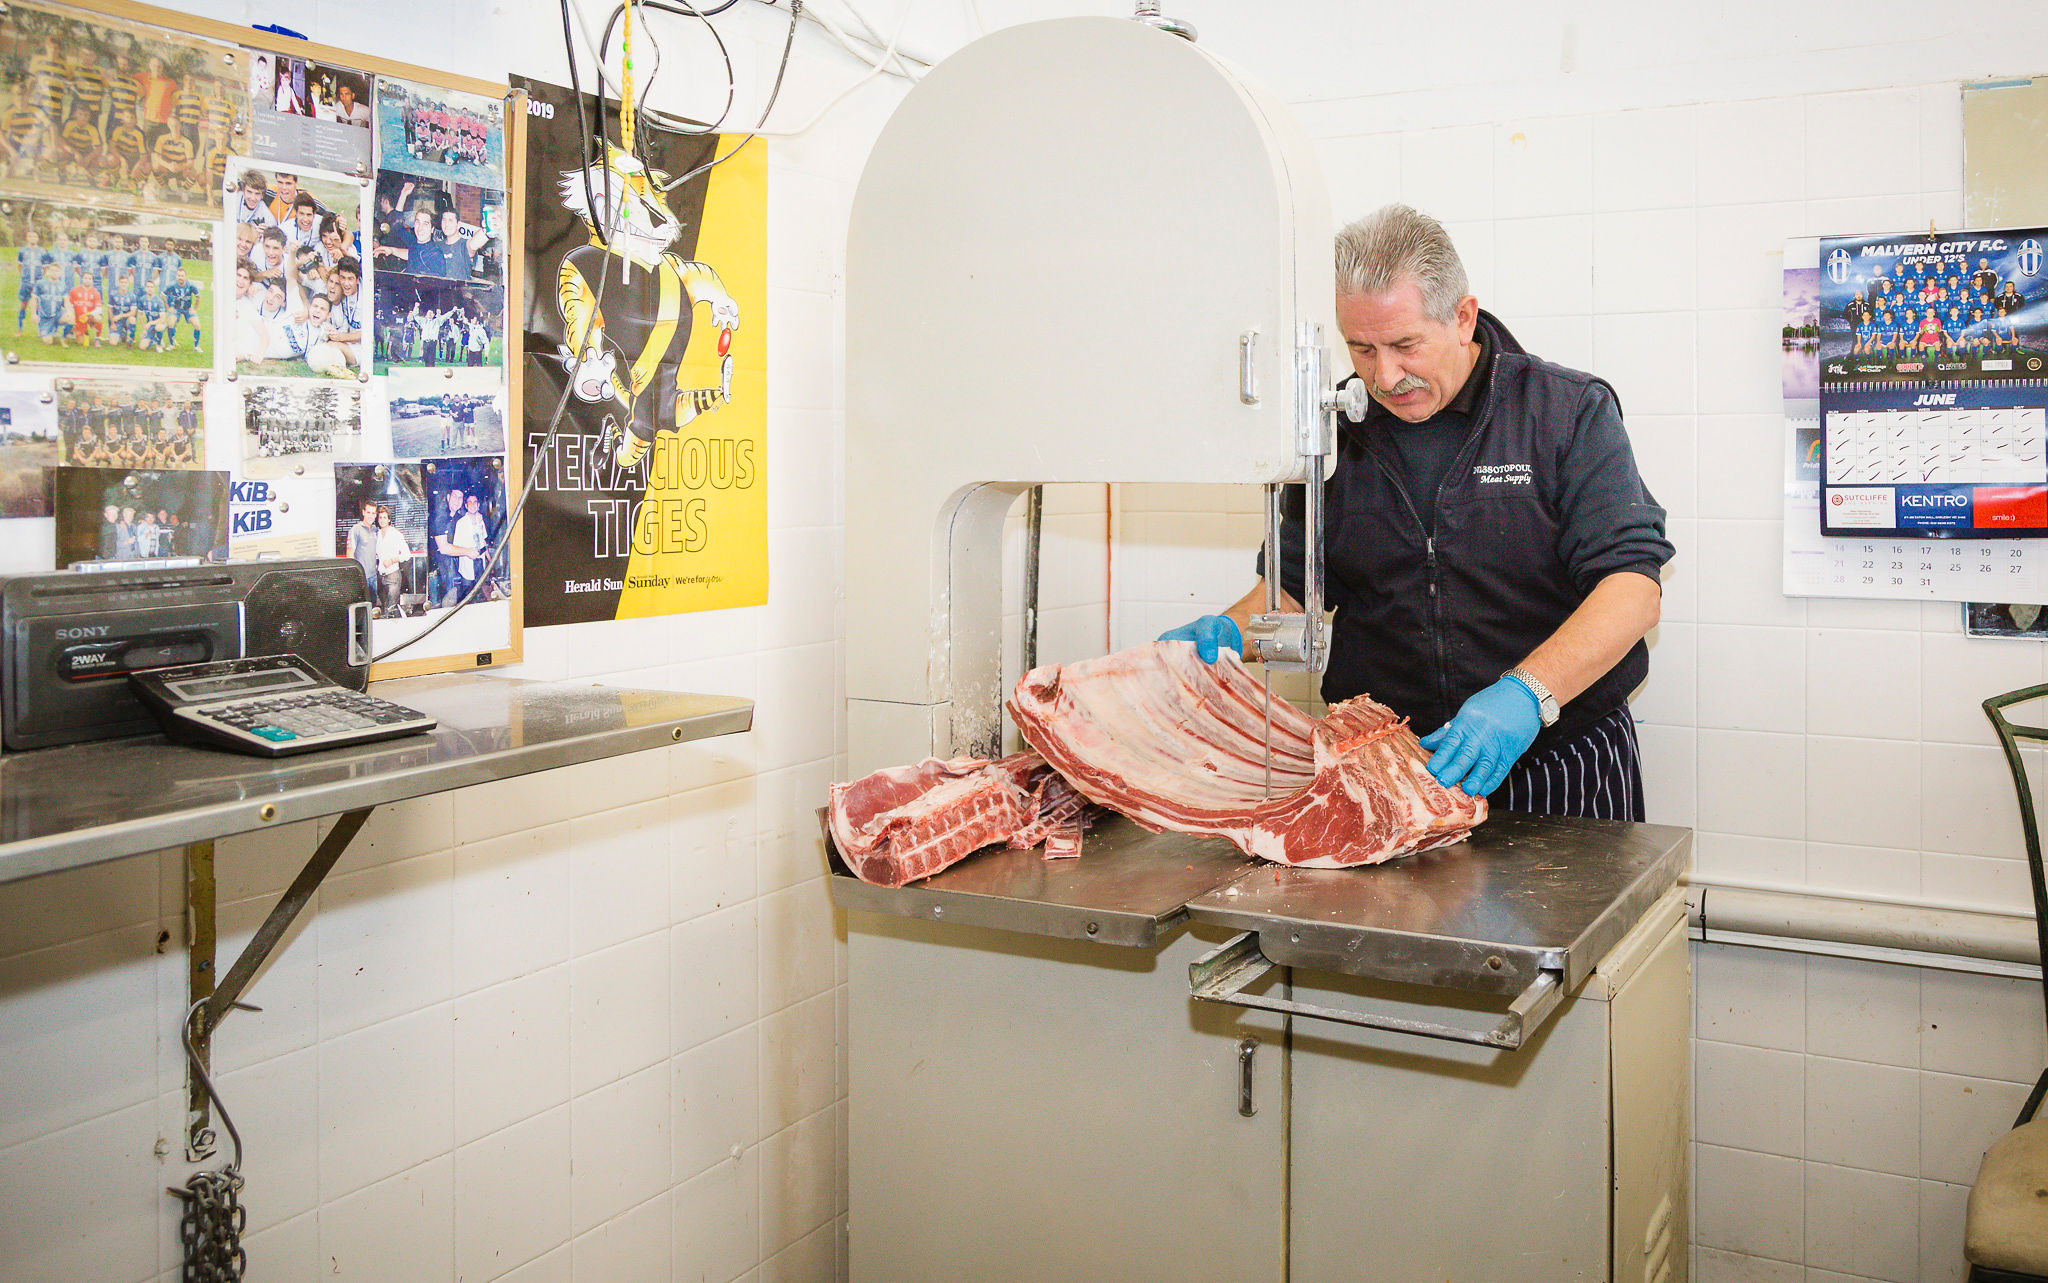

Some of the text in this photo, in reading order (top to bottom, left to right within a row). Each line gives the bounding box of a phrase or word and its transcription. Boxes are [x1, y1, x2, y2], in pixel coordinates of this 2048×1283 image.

[527, 99, 554, 119] 2019
[1861, 239, 2008, 257] MALVERN CITY F.C.
[1902, 254, 1966, 265] UNDER 12'S
[1913, 394, 1957, 406] JUNE
[528, 432, 755, 492] TENACIOUS
[1480, 473, 1531, 485] Meat Supply
[230, 481, 269, 502] KiB
[1902, 494, 1968, 507] KENTRO
[233, 509, 272, 534] KiB
[588, 498, 708, 559] TIGES
[1835, 544, 1845, 552] 14
[1864, 545, 1874, 553] 15
[1893, 546, 1903, 554] 16
[1921, 547, 1932, 555] 17
[1980, 548, 1991, 556] 19
[2010, 549, 2022, 557] 20
[1980, 564, 1991, 572] 26
[2010, 565, 2022, 573] 27
[564, 579, 624, 594] Herald Sun
[628, 575, 671, 589] Sunday
[675, 576, 694, 585] We're
[696, 575, 705, 583] for
[1834, 575, 1930, 586] 28 29 30 31
[55, 625, 111, 640] SONY
[71, 653, 107, 666] 2WAY
